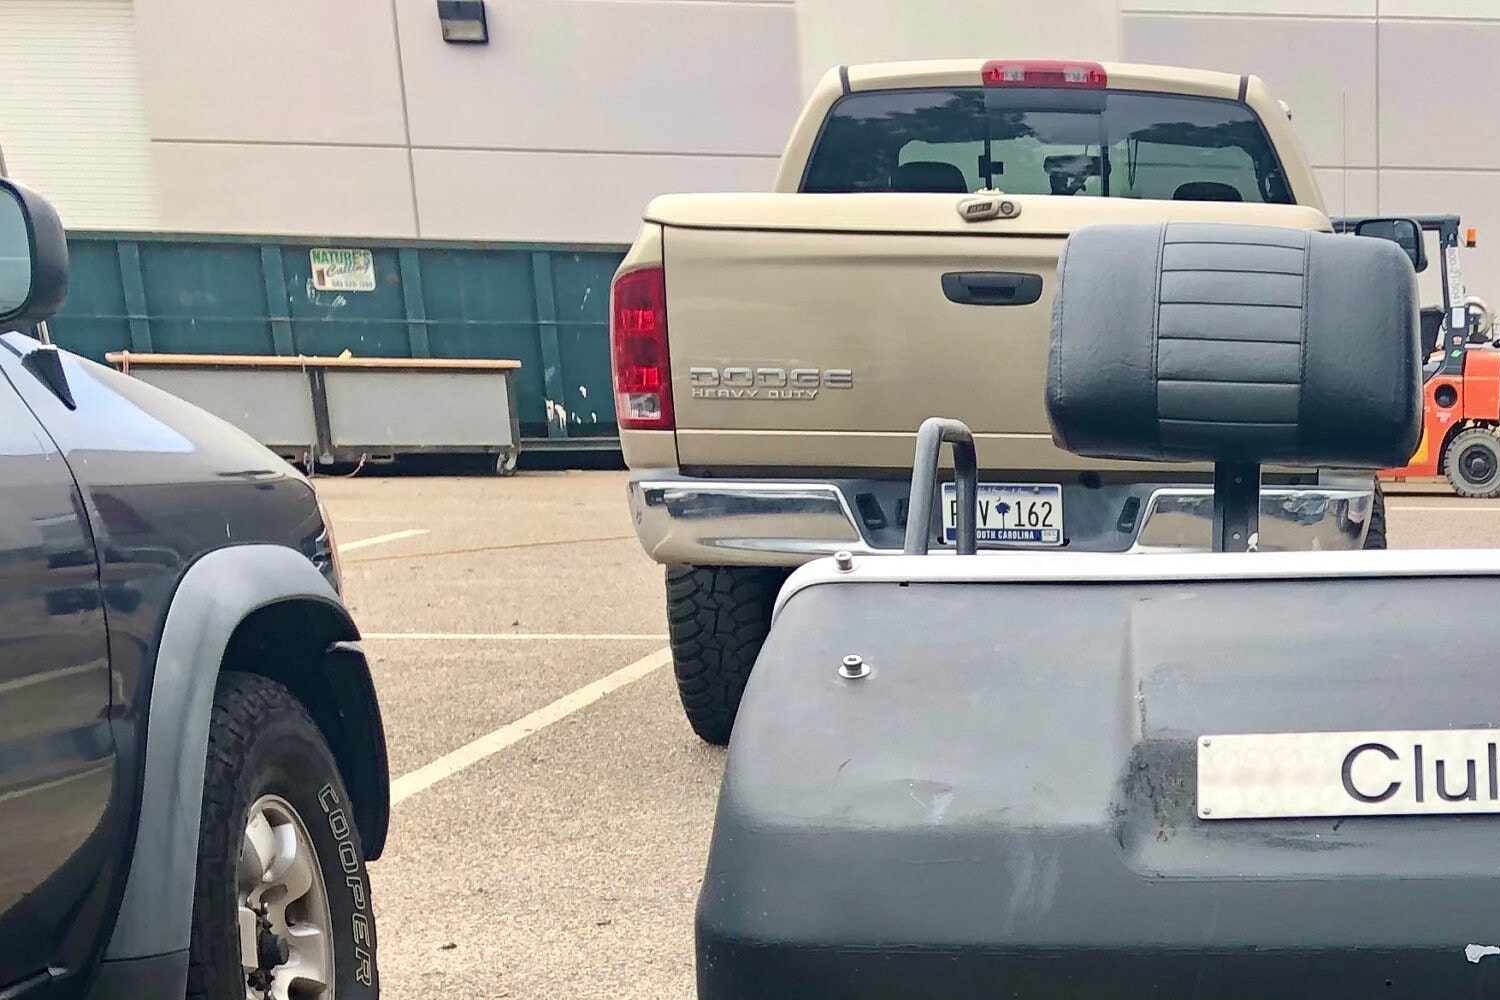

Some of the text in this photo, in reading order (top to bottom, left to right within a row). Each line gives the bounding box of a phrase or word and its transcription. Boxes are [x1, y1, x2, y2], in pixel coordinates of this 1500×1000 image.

[690, 367, 853, 389] DODGE
[692, 388, 819, 399] HEAVY DUTY
[1014, 500, 1054, 528] 162
[976, 530, 996, 540] OUTH
[997, 530, 1035, 540] CAROLINA
[317, 783, 372, 987] COOPER
